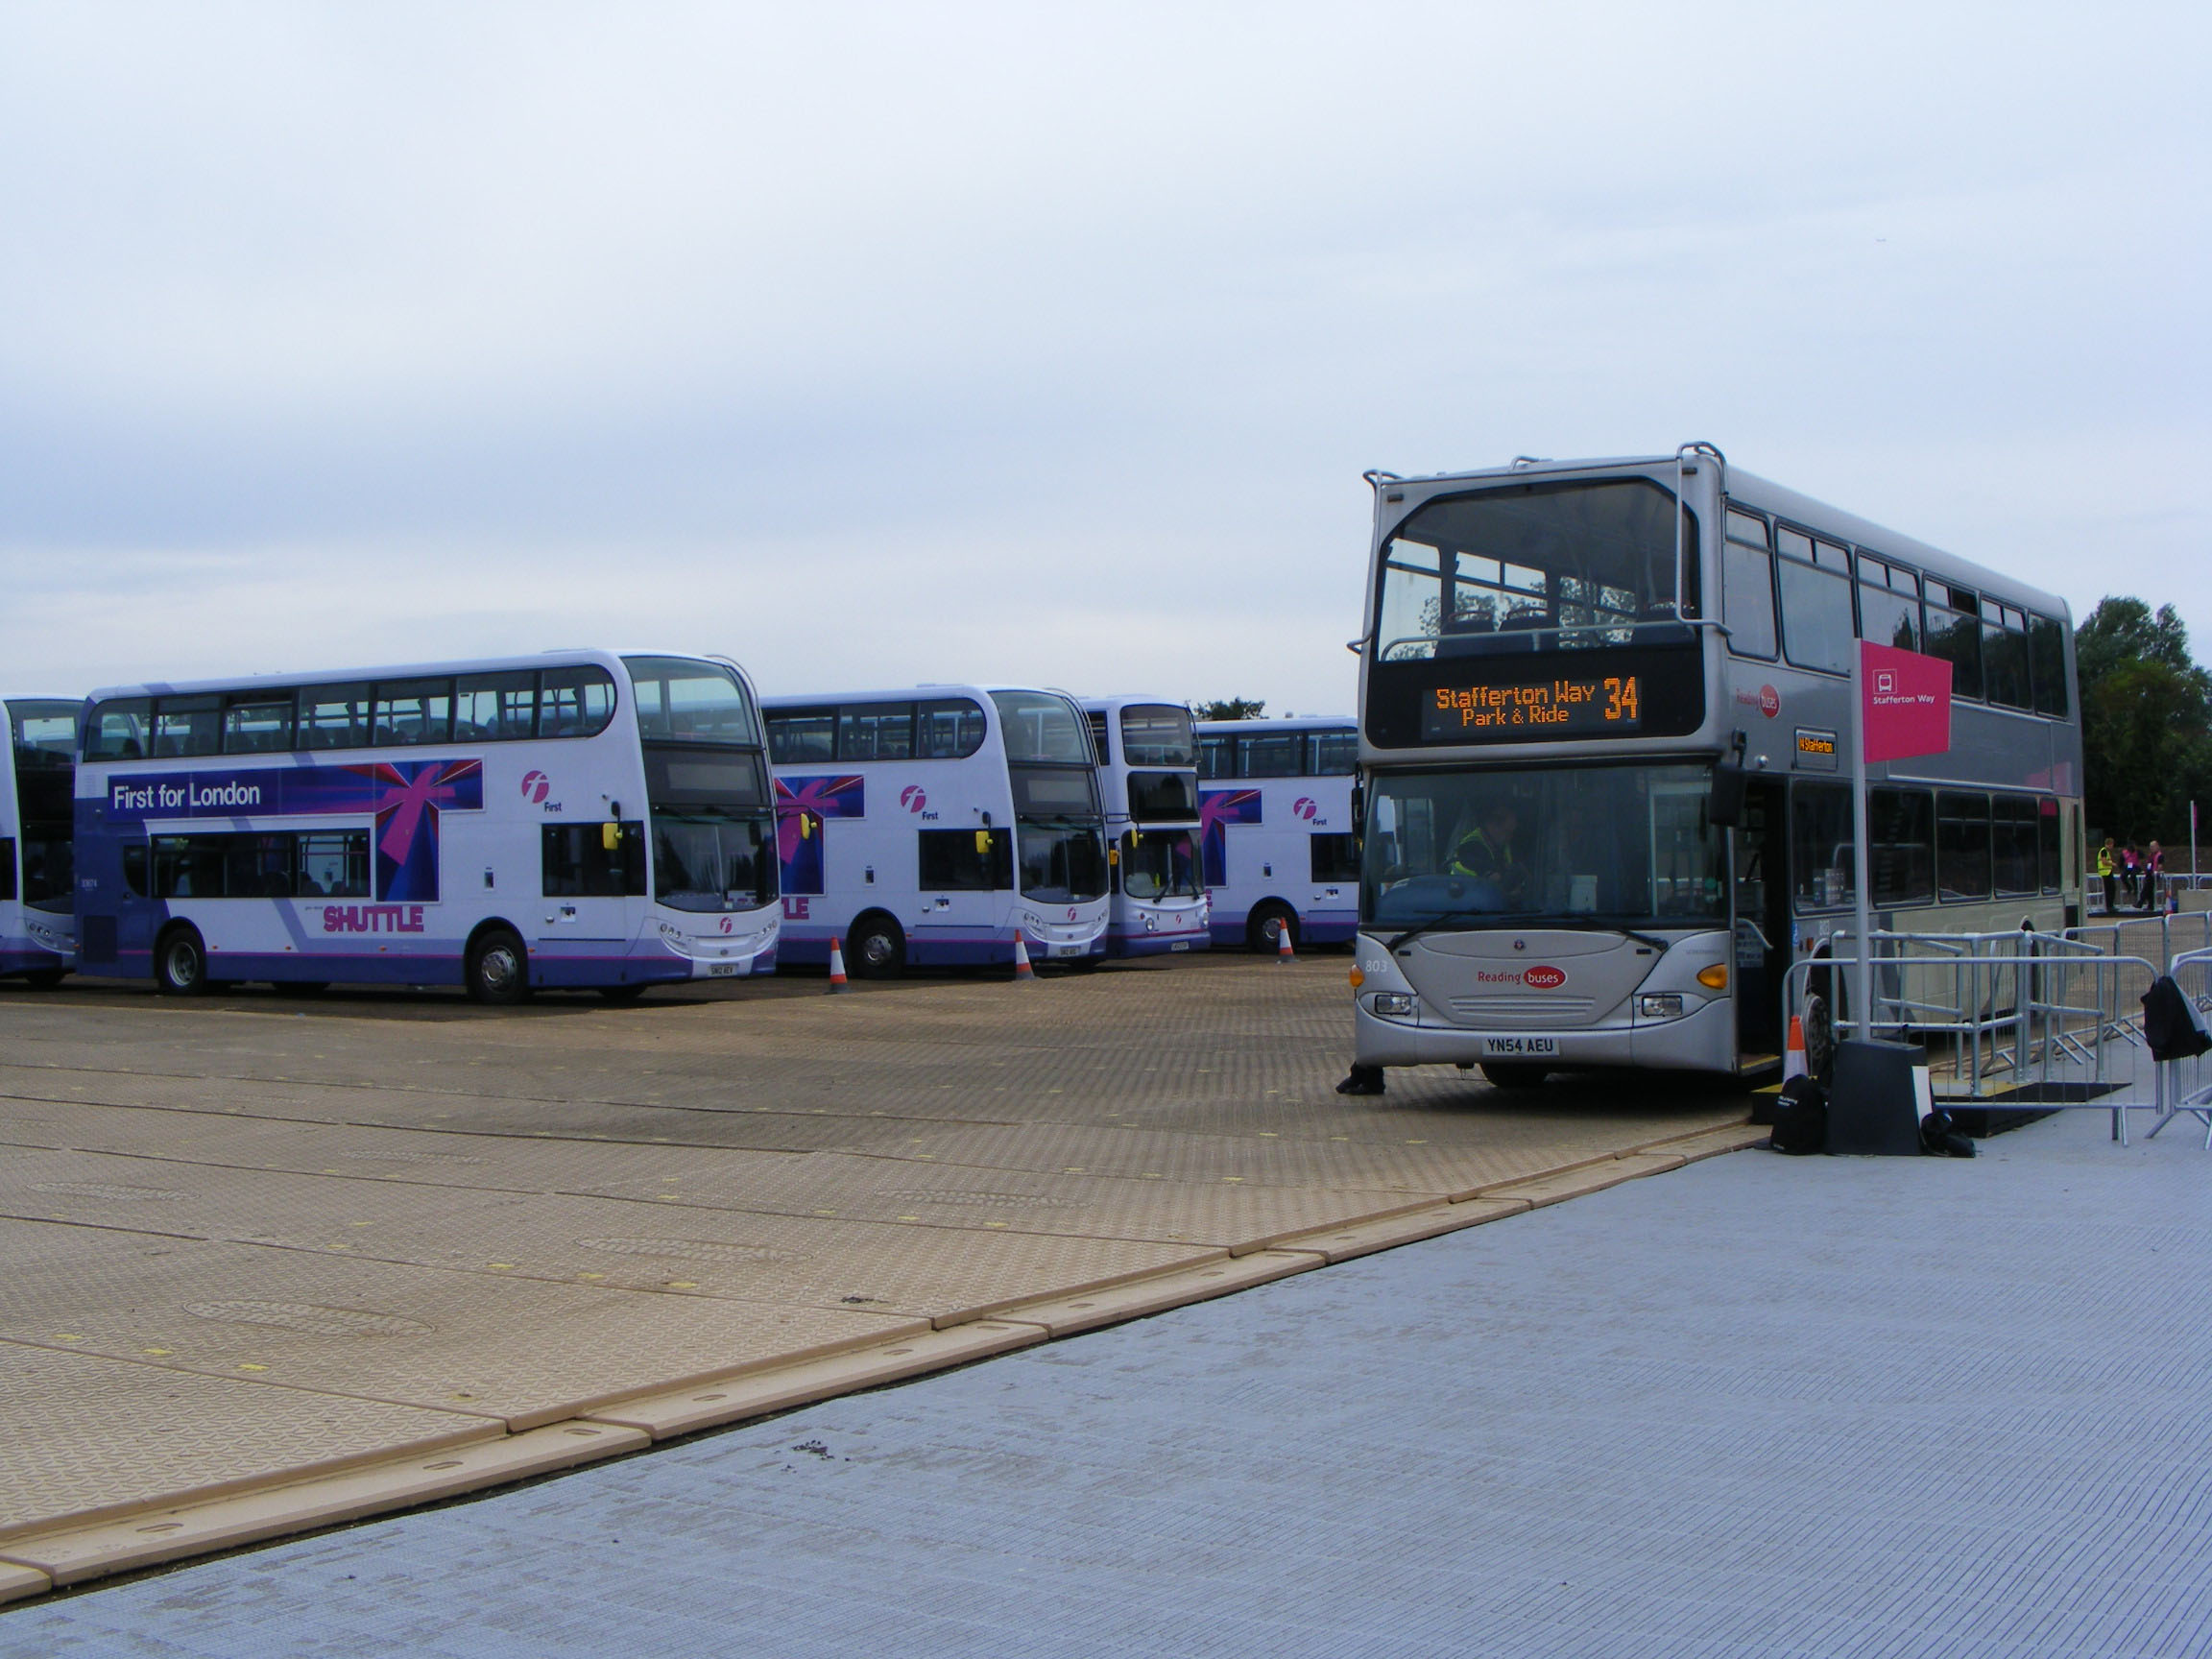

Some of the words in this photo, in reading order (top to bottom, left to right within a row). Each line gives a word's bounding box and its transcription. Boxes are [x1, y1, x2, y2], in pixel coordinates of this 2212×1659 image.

[1436, 686, 1549, 709] Stafferton
[1554, 680, 1596, 703] Way
[1603, 676, 1638, 720] 34
[1873, 695, 1915, 705] Stafferton
[1917, 694, 1936, 705] Way
[1461, 707, 1506, 727] Park
[1512, 708, 1525, 724] &
[1528, 705, 1570, 723] Ride
[114, 785, 154, 809] First
[158, 783, 185, 807] for
[189, 781, 260, 806] London
[544, 801, 562, 812] First
[922, 810, 938, 821] First
[324, 905, 424, 932] SHUTTLE
[1366, 960, 1387, 973] 803
[1478, 971, 1522, 985] Reading
[1527, 972, 1559, 984] buses
[1487, 1038, 1523, 1052] YN54
[1527, 1038, 1553, 1052] AEU
